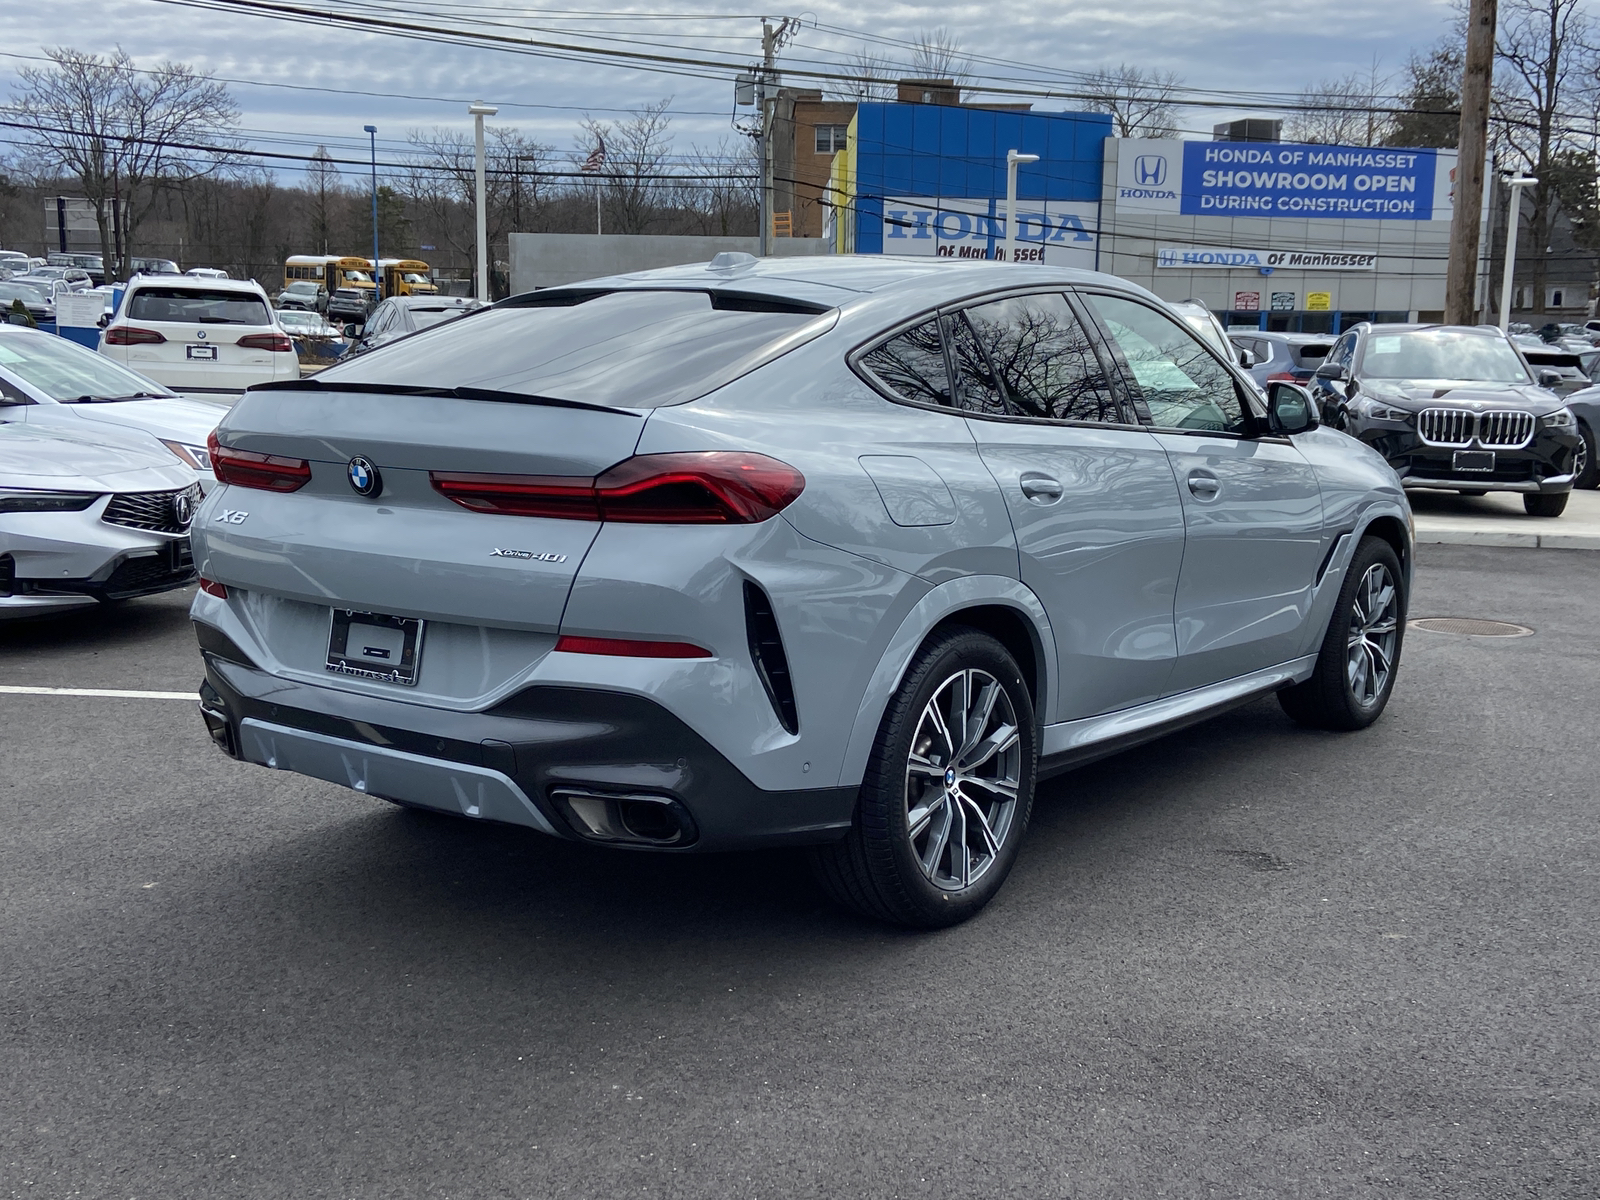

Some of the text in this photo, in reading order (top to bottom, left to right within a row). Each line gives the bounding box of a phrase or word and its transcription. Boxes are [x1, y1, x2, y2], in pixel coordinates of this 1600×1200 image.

[1205, 149, 1417, 168] HONDA OF MANHASSET
[1202, 170, 1416, 192] SHOWROOM OPEN
[1120, 189, 1177, 199] HONDA
[1200, 194, 1415, 213] DURING CONSTRUCTION
[887, 210, 1094, 242] HONDA
[958, 245, 1045, 262] Manhsset
[1182, 252, 1376, 266] HONDA Of Manhasset
[215, 509, 249, 525] X6
[325, 664, 410, 684] MANHASSET
